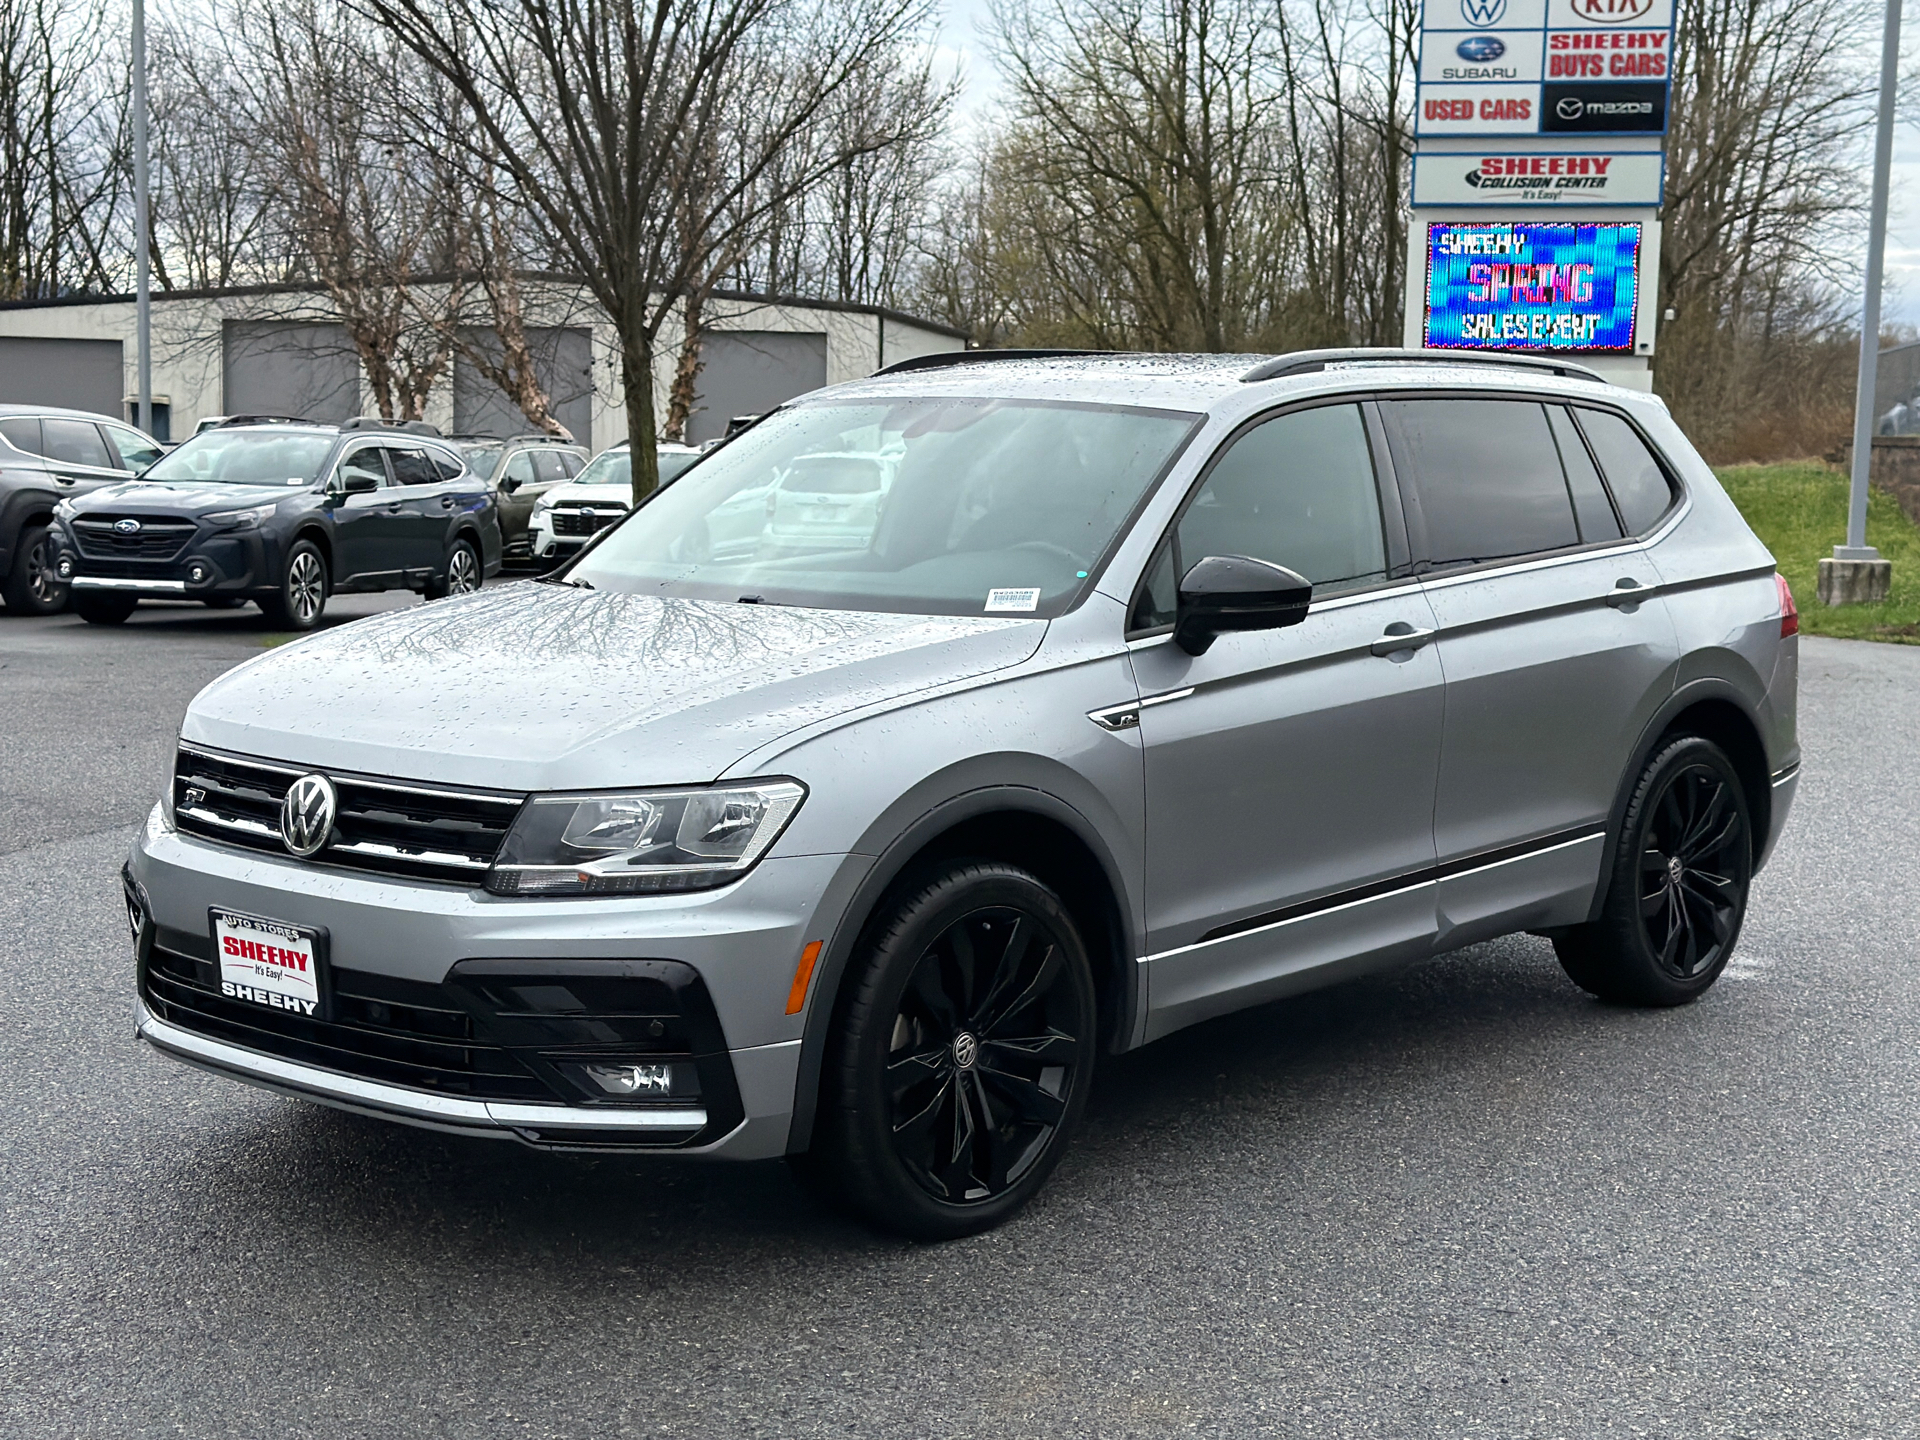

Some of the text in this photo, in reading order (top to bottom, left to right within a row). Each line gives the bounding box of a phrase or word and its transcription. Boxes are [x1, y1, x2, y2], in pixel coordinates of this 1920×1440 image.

[1550, 33, 1668, 50] SHEEHY
[1442, 67, 1517, 79] SUBARU
[1550, 53, 1666, 78] BUYS CARS
[1424, 98, 1532, 121] USED CARS
[1480, 157, 1612, 175] SHEEHY
[1480, 177, 1609, 189] COLLISION CENTER
[1438, 232, 1527, 255] SHEEHY
[1461, 313, 1529, 339] SALES
[222, 914, 300, 940] AUTO STORES
[223, 935, 308, 972] SHEEHY
[255, 964, 283, 982] It's Easy!
[221, 981, 316, 1016] SHEEHY
